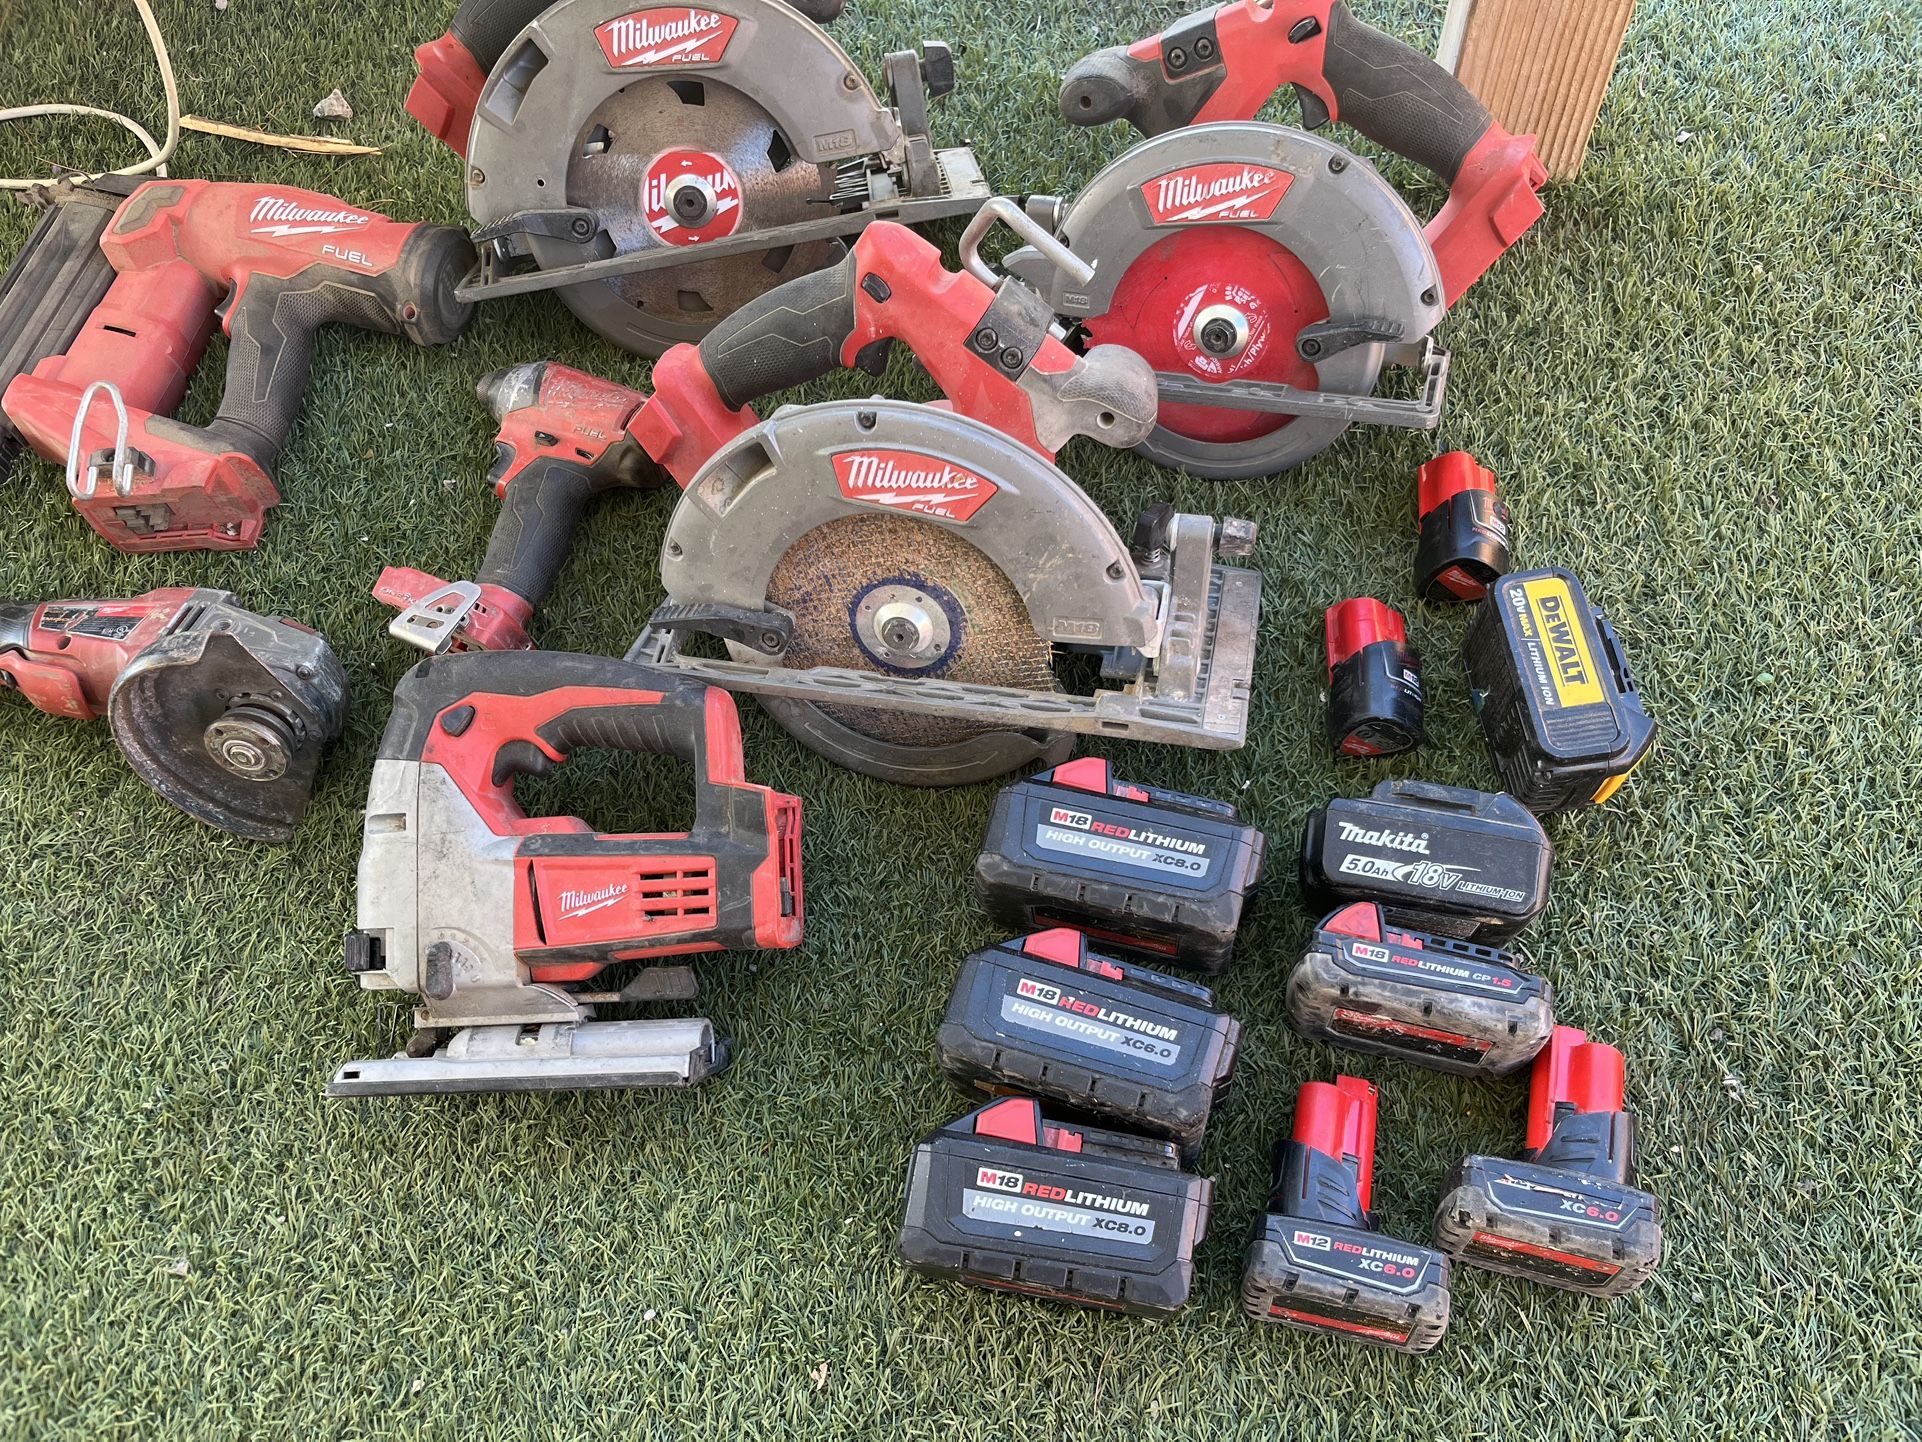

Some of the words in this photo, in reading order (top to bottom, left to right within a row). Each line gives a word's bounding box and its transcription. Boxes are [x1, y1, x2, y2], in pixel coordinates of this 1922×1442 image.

[604, 10, 722, 57] Milwaukee
[672, 52, 710, 62] FUEL
[816, 135, 853, 152] M18
[1157, 168, 1275, 213] Milwaukee
[250, 196, 369, 225] Milwaukee
[1218, 209, 1259, 219] FUEL
[322, 245, 373, 267] FUEL
[842, 456, 979, 489] Milwaukee
[912, 503, 955, 518] FUEL
[1056, 620, 1100, 635] M18
[1518, 613, 1533, 638] MAX
[1527, 641, 1547, 686] LITHIUM
[1540, 686, 1555, 706] ION
[1052, 810, 1089, 826] M18
[1090, 821, 1206, 855] REDLITHIUM
[1045, 830, 1085, 847] HIGH
[1088, 837, 1152, 861] OUTPUT
[1152, 852, 1202, 872] XC8.0
[558, 883, 630, 912] Milwaukee
[1354, 945, 1387, 961] M18
[1391, 954, 1469, 979] REDLITHIUM
[1019, 981, 1058, 1000] M18
[1011, 1001, 1052, 1022] HIGH
[1055, 1014, 1121, 1043] OUTPUT
[1120, 1034, 1172, 1058] XC6.0
[979, 1170, 1020, 1189] M18
[1022, 1182, 1150, 1217] REDLITHIUM
[971, 1194, 1018, 1213] HIGH
[1020, 1204, 1092, 1226] OUTPUT
[1091, 1216, 1147, 1237] XC8.0
[1560, 1198, 1619, 1222] XC6.0
[1296, 1232, 1329, 1248] M12
[1333, 1241, 1419, 1267] REDLITHIUM
[1358, 1258, 1416, 1279] XC6.0
